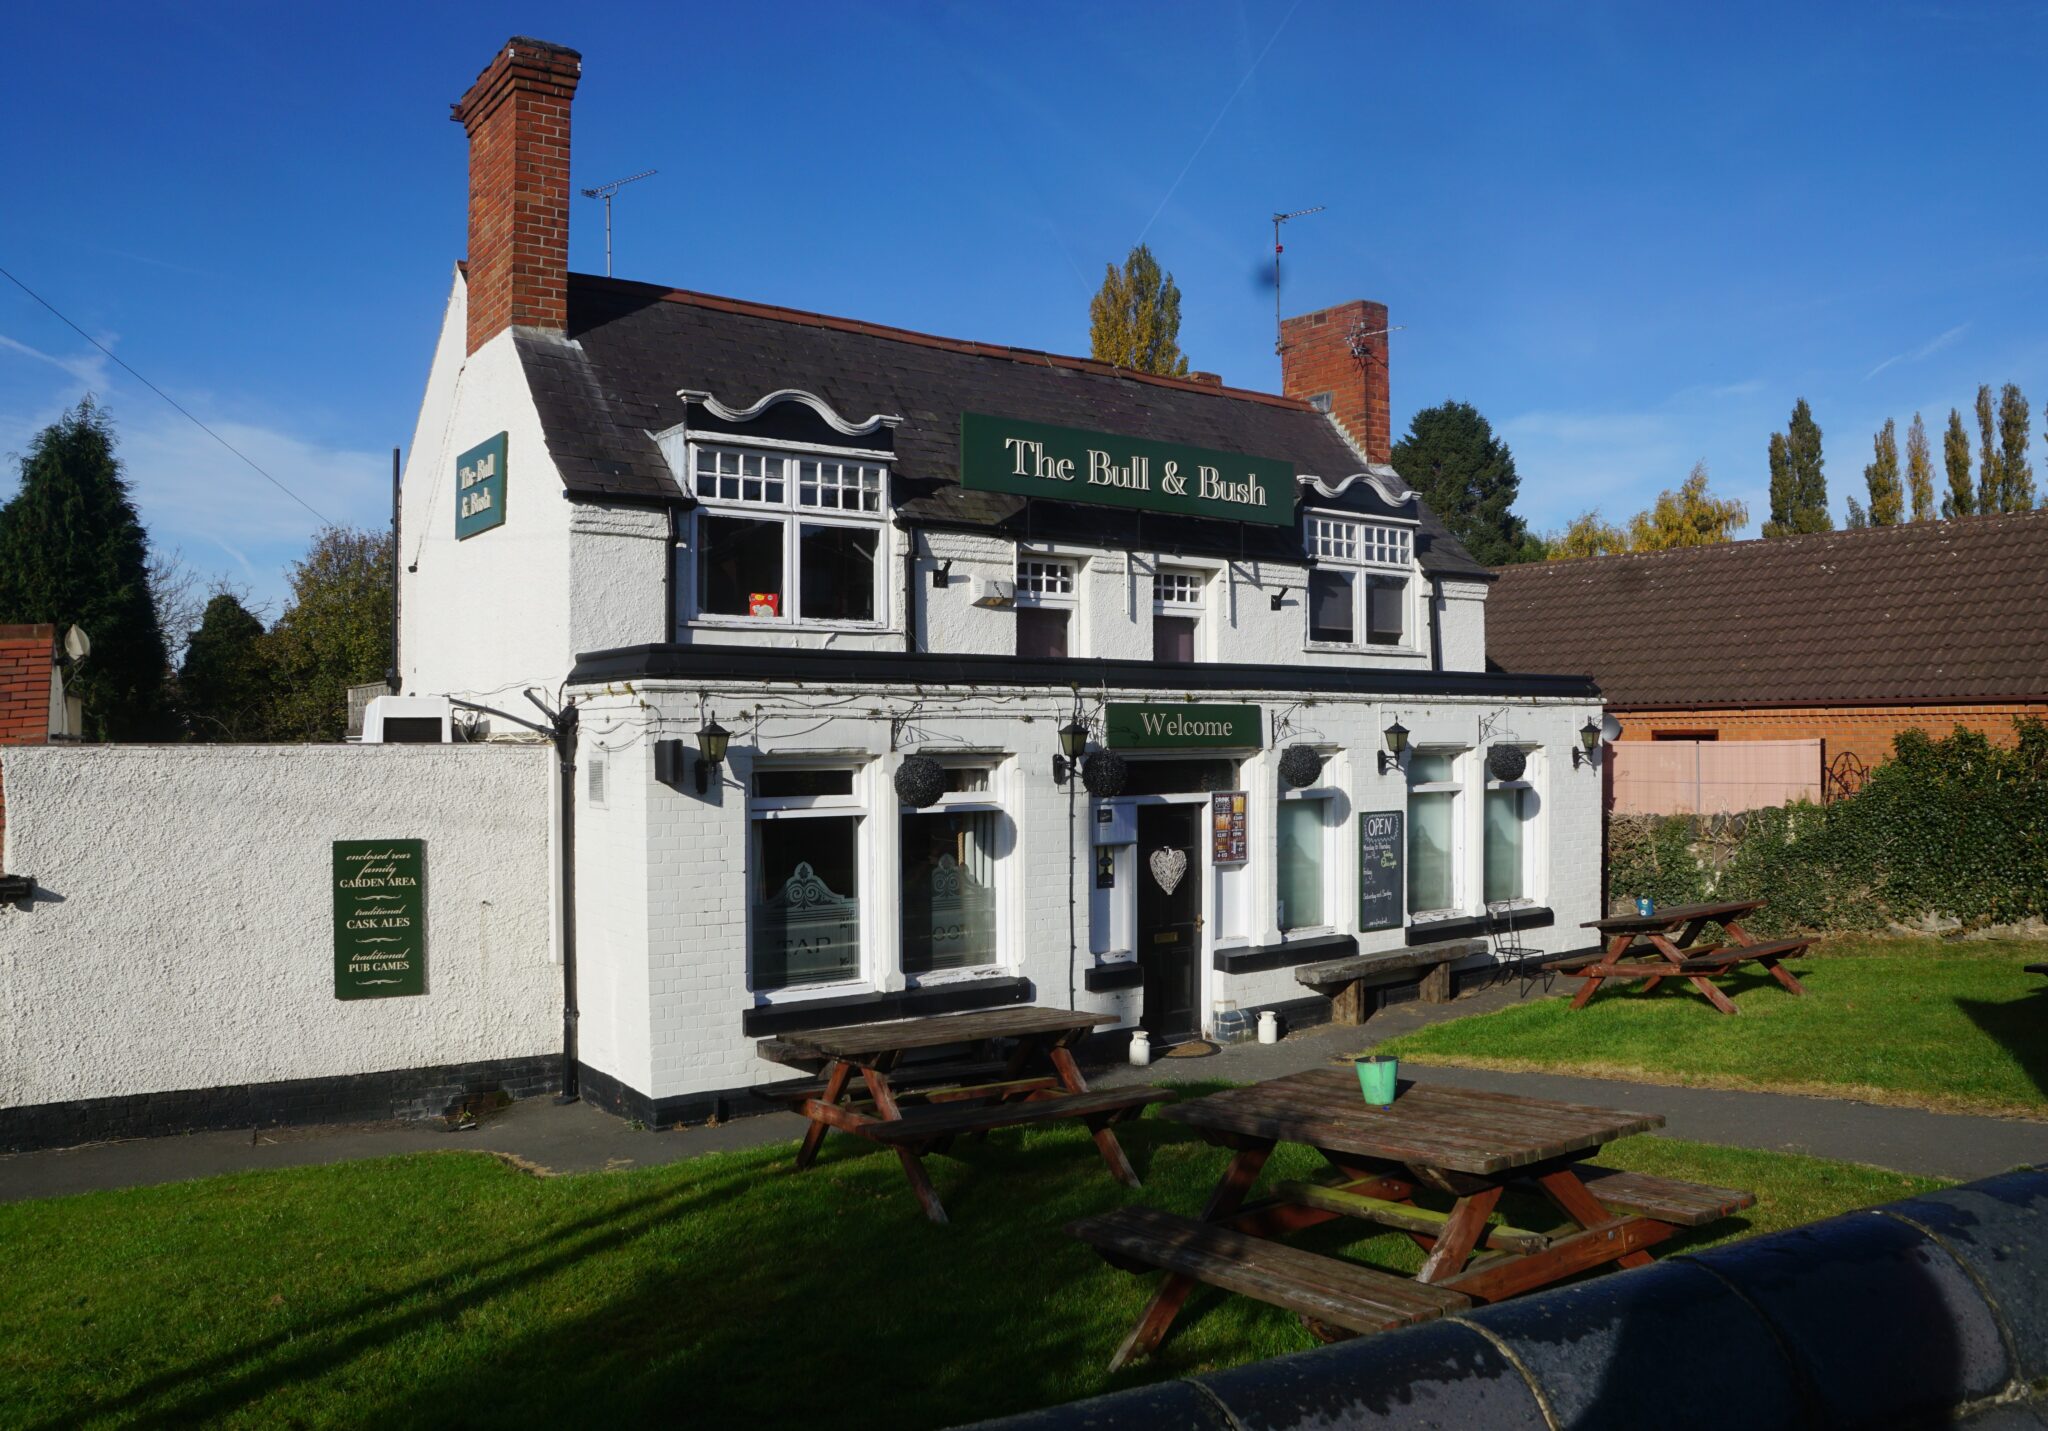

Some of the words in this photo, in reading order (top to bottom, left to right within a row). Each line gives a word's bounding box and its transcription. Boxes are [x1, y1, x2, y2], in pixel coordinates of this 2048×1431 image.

[460, 466, 477, 490] The
[477, 453, 495, 482] Bull
[1005, 438, 1076, 481] The
[1087, 449, 1151, 491] Bull
[1161, 460, 1188, 496] &
[1197, 465, 1267, 506] Bush
[470, 487, 492, 515] Bush
[1140, 712, 1233, 736] Welcome
[1368, 817, 1392, 836] OPEN
[346, 849, 392, 861] enclosed
[391, 852, 411, 860] rear
[355, 860, 397, 881] family
[339, 878, 385, 888] GARDEN
[387, 877, 417, 887] AREA
[354, 905, 405, 916] traditional
[346, 919, 379, 929] CASK
[381, 917, 410, 928] ALES
[351, 948, 410, 962] traditional
[349, 963, 370, 973] PUB
[372, 961, 410, 972] GAMES
